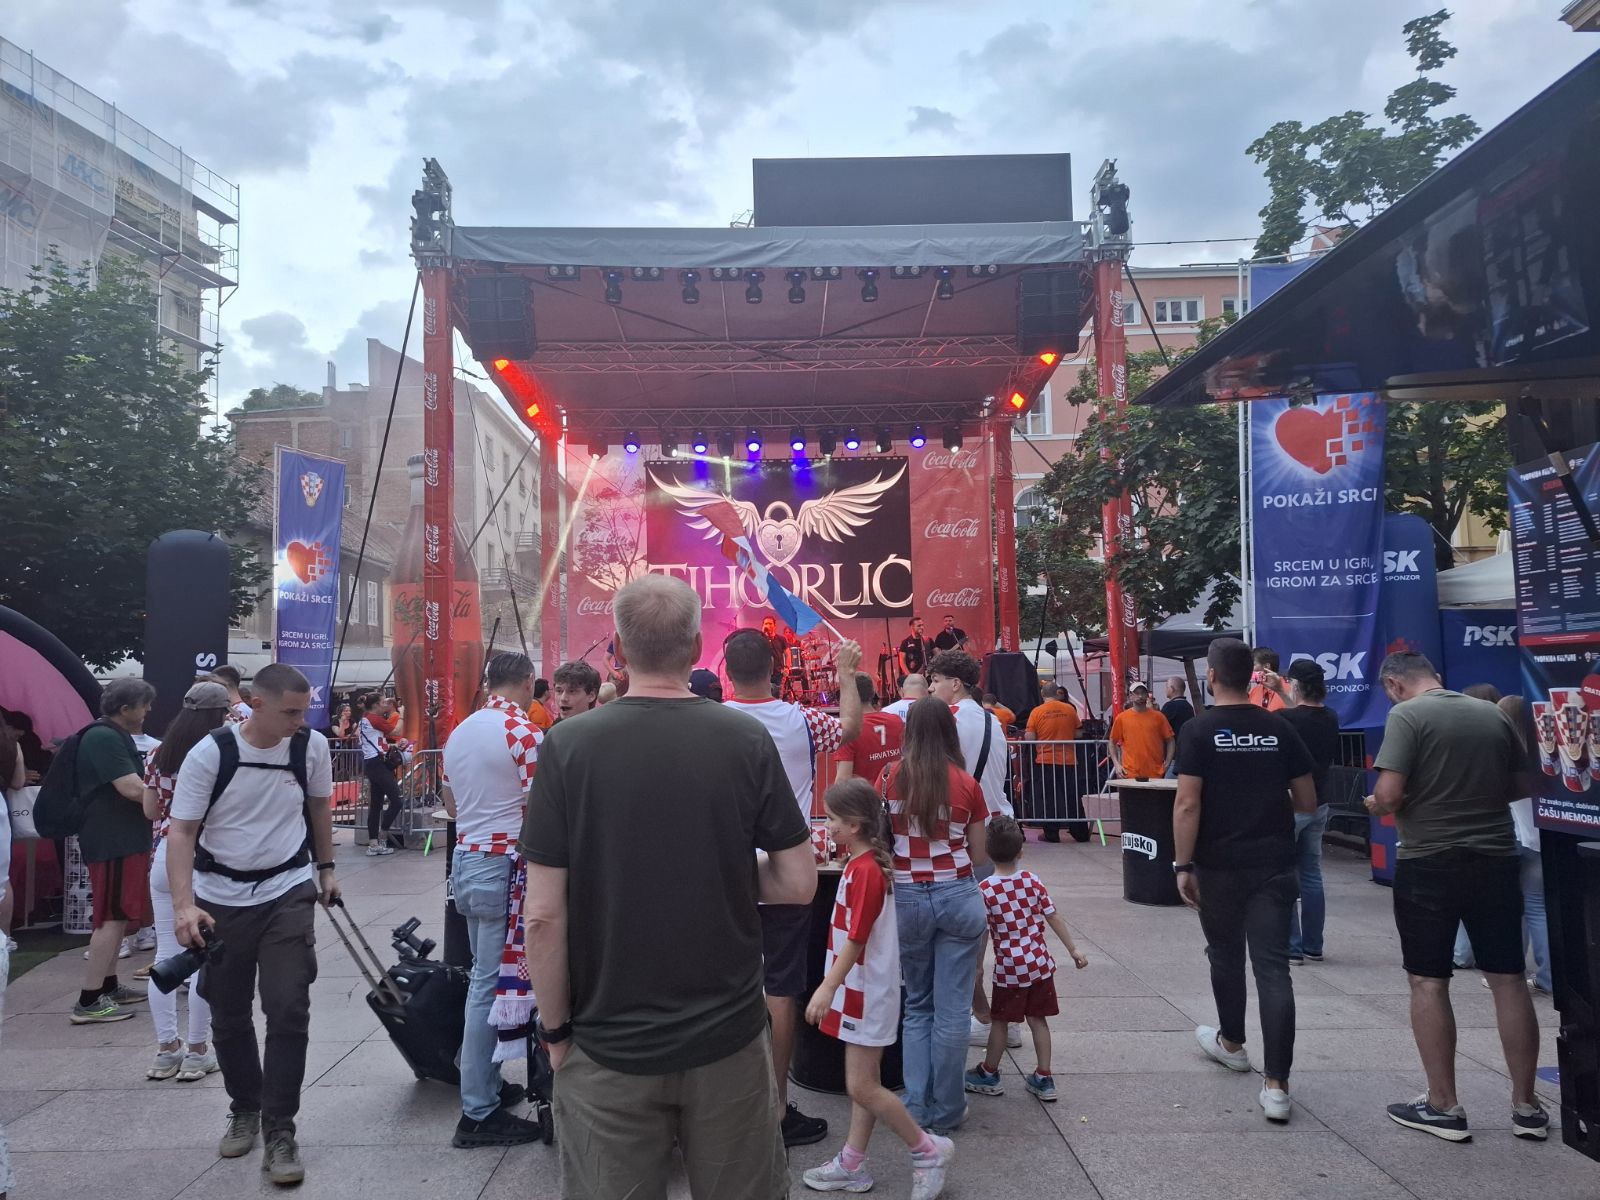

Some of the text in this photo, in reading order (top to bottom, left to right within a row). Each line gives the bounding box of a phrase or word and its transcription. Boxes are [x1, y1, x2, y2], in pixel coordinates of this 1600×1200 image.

[1263, 488, 1331, 508] POKAŽI
[924, 519, 981, 538] Coca-Cola
[1274, 557, 1374, 572] SRCEM U IGRI,
[1384, 550, 1421, 573] SK
[1267, 576, 1316, 588] IGROM
[1321, 575, 1341, 586] ZA
[280, 591, 333, 604] POKAŽI SRCE
[927, 588, 982, 608] Coca-Cola
[577, 596, 614, 616] Coca-C
[281, 630, 303, 639] SRCEM
[305, 632, 310, 640] U
[1463, 625, 1518, 647] PSK
[279, 640, 299, 649] IGROM
[301, 641, 310, 649] ZA
[873, 724, 887, 746] 7
[1213, 733, 1279, 747] Eldra
[870, 748, 901, 761] HRVATSKA
[1538, 806, 1560, 819] ČAŠU
